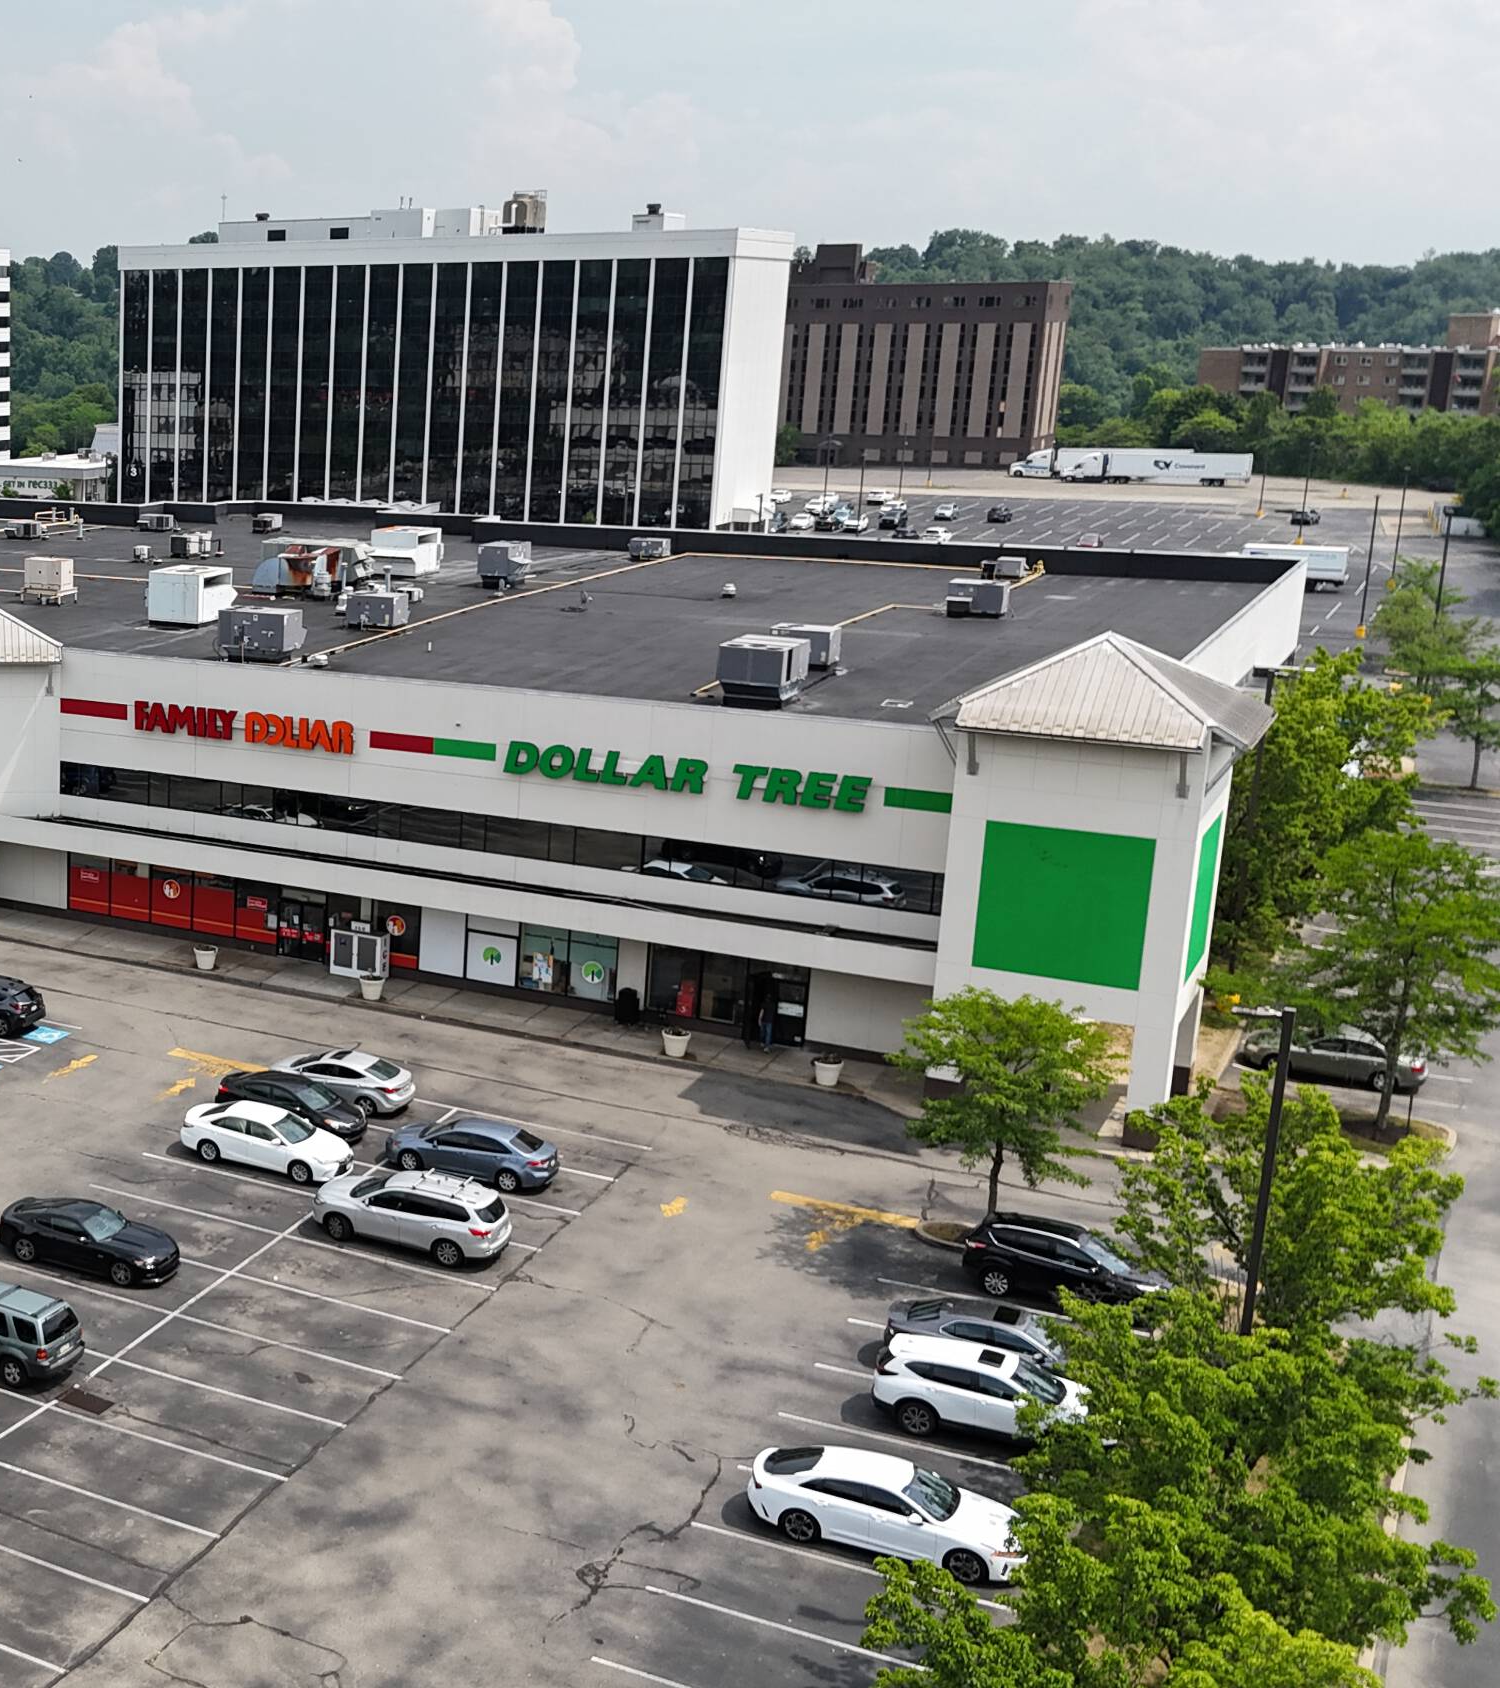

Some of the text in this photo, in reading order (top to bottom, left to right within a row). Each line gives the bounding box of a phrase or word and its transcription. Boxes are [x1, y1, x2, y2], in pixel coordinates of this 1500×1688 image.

[130, 467, 137, 476] 3
[135, 700, 354, 755] FAMILY DOLLAR
[503, 740, 872, 813] DOLLAR TREE
